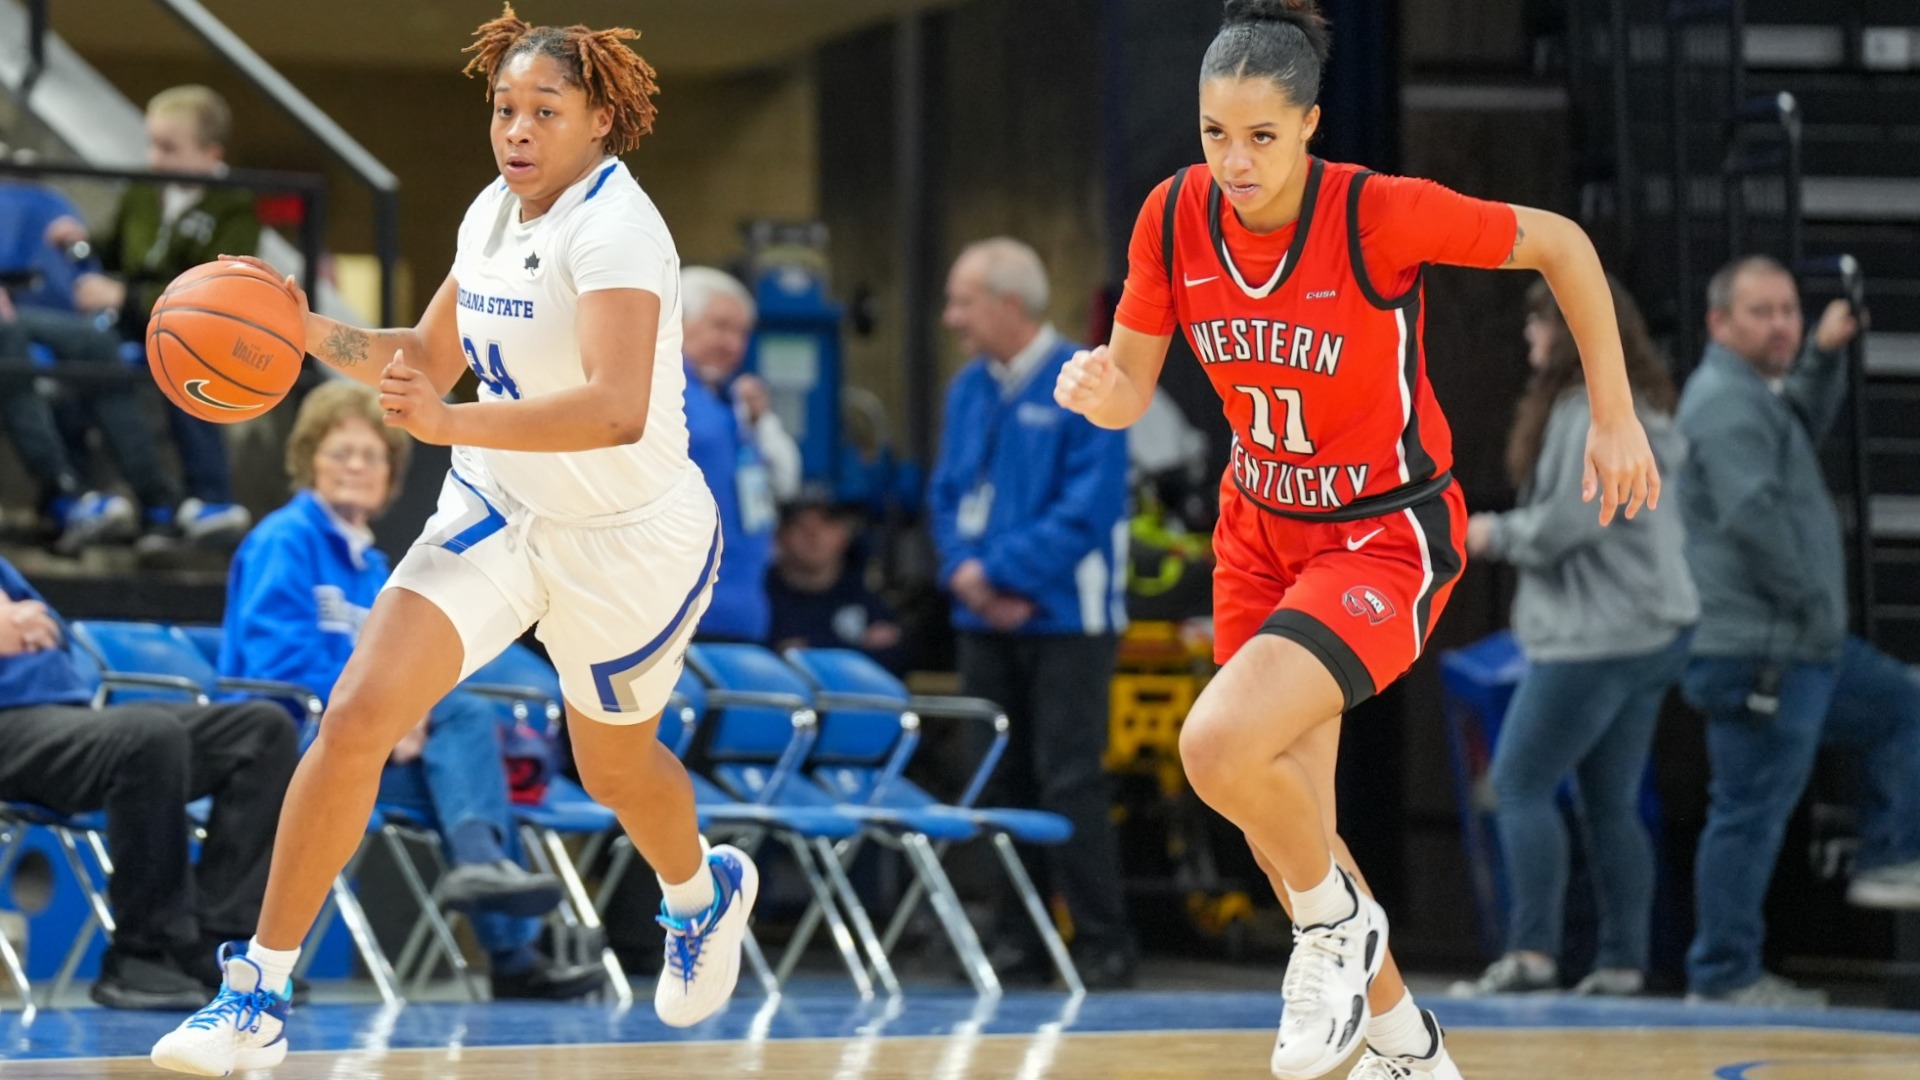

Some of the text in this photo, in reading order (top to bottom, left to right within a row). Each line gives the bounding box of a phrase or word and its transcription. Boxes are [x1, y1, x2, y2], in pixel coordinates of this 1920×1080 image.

[487, 296, 534, 319] STATE
[1306, 290, 1336, 299] C-USA
[232, 337, 274, 371] VALLEY
[1190, 318, 1344, 376] WESTERN
[1234, 385, 1315, 454] 11
[1231, 431, 1369, 508] ENTUCKY
